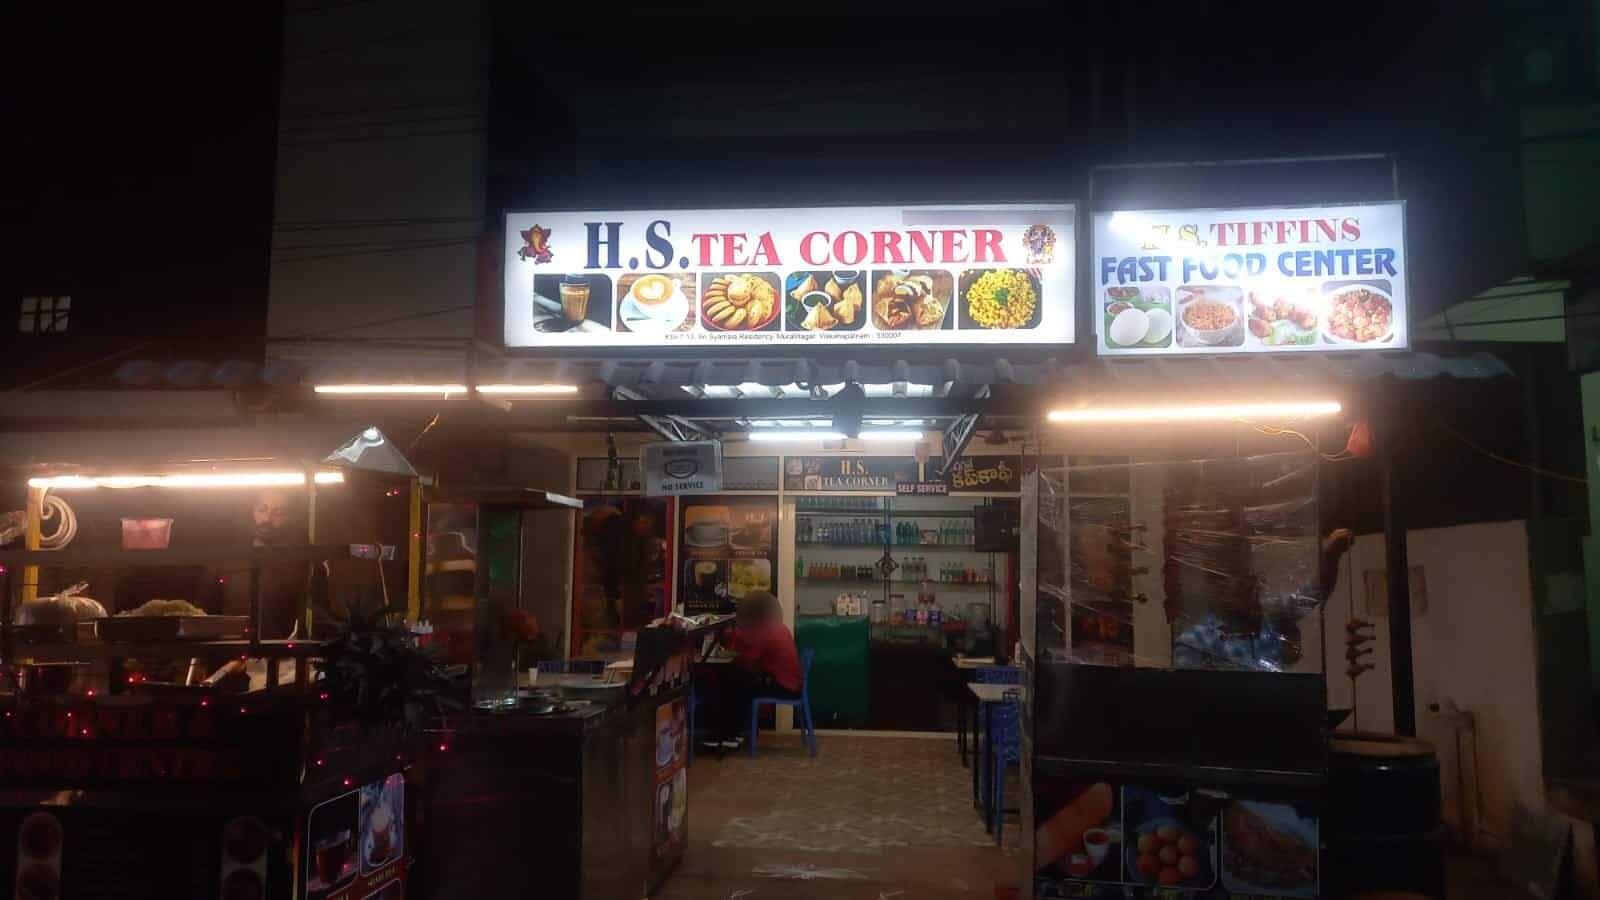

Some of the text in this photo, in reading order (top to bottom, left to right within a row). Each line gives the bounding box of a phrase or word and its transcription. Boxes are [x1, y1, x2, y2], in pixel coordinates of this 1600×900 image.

[1209, 217, 1361, 247] TIFFINS
[584, 220, 1008, 270] H.S. TEA CORNER
[1101, 247, 1398, 285] FAST FOOD CENTER
[840, 460, 869, 475] H.S.
[662, 480, 704, 491] NO SERVICE
[824, 476, 889, 488] TEA CORNER
[898, 483, 948, 493] SELF SERVICE
